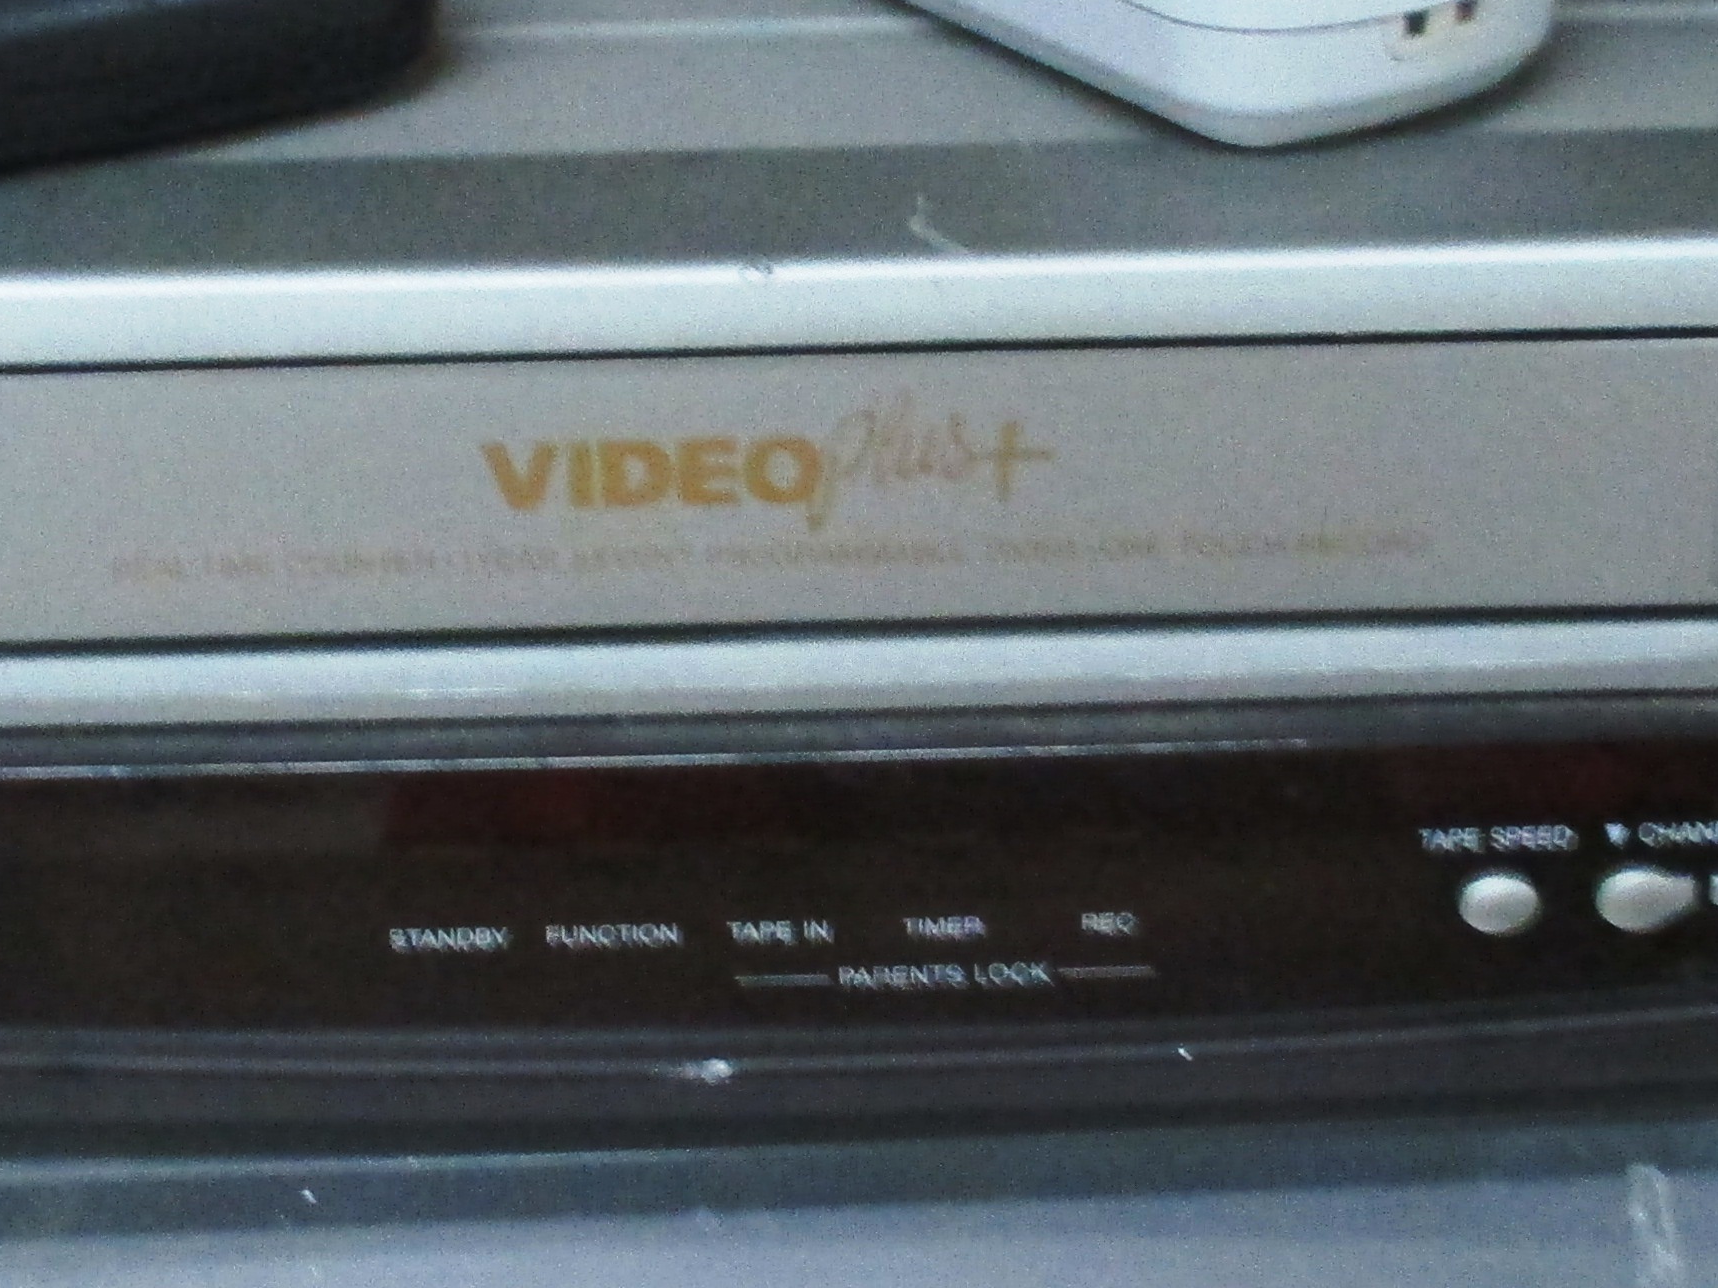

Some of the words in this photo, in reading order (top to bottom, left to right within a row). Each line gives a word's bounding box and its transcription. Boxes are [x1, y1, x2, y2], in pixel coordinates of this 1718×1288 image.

[1419, 826, 1483, 853] TAPE
[1489, 822, 1580, 852] SPEED
[388, 925, 513, 954] STANDBY
[544, 922, 683, 950] FUNCTION
[726, 919, 794, 947] TAPE
[801, 918, 835, 945] IN
[902, 914, 988, 942] TIMER
[837, 964, 966, 991] PARENTS
[973, 960, 1056, 989] LOCK
